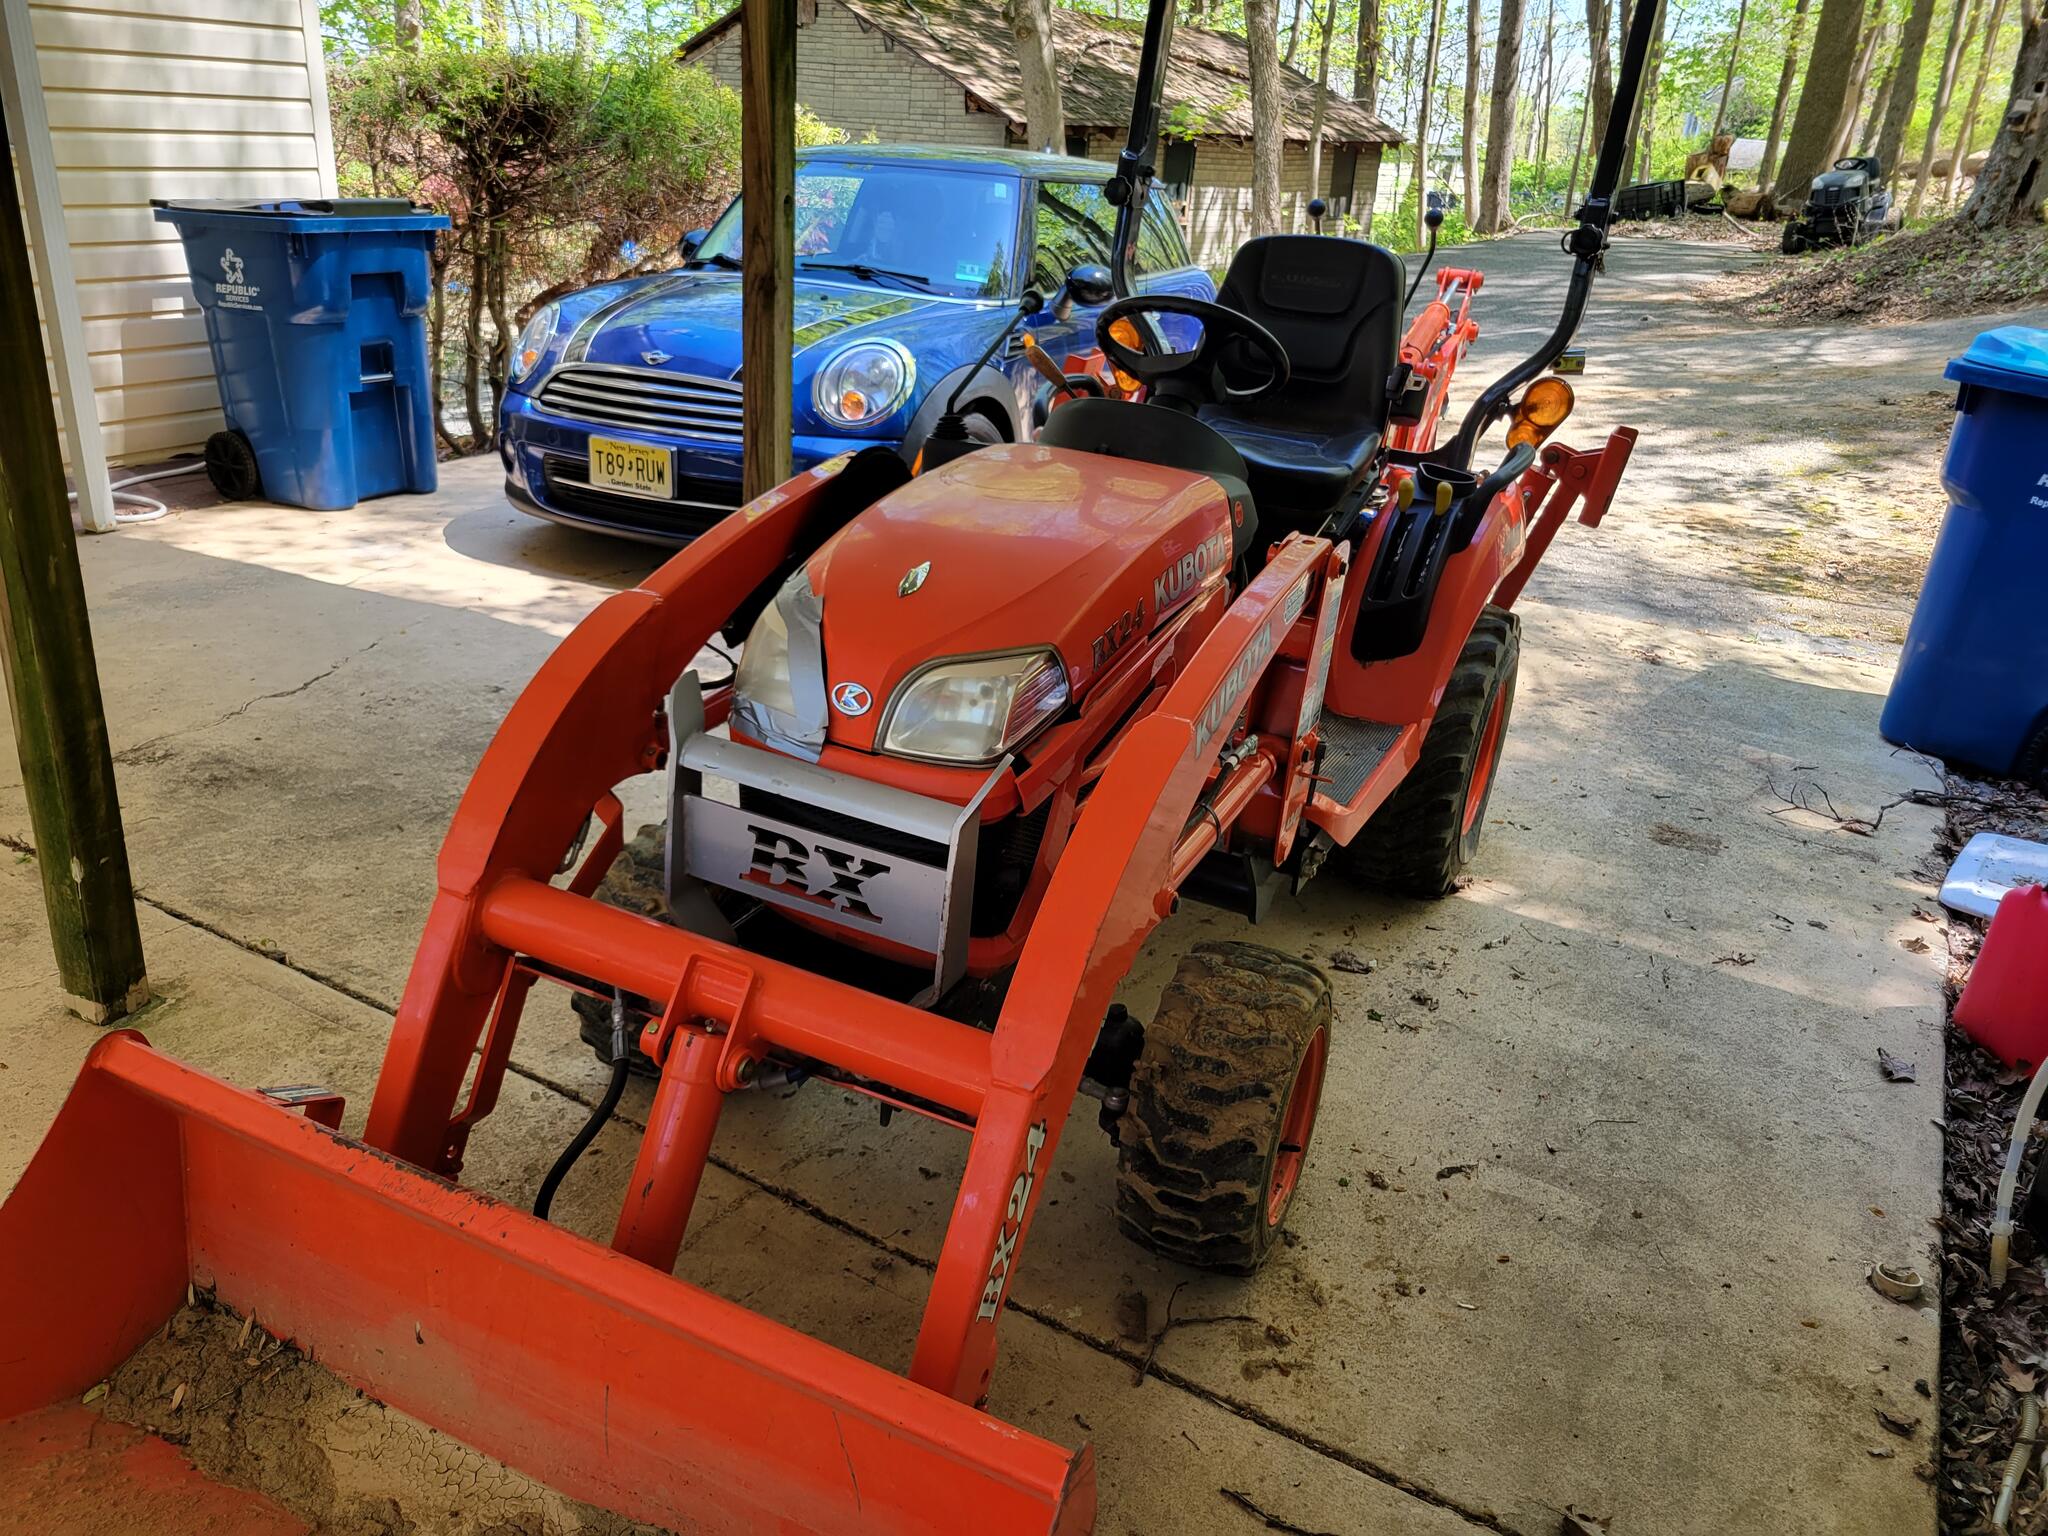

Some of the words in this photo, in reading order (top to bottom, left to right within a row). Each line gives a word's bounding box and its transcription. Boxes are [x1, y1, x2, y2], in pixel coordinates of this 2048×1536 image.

[216, 283, 258, 296] REPUBLIC
[609, 441, 626, 452] New
[628, 444, 650, 456] Jersey
[610, 479, 633, 489] Garden
[635, 482, 652, 491] State
[1153, 533, 1226, 613] KUBOTA
[1194, 620, 1273, 759] KUBOTA
[976, 1118, 1047, 1324] BX24
